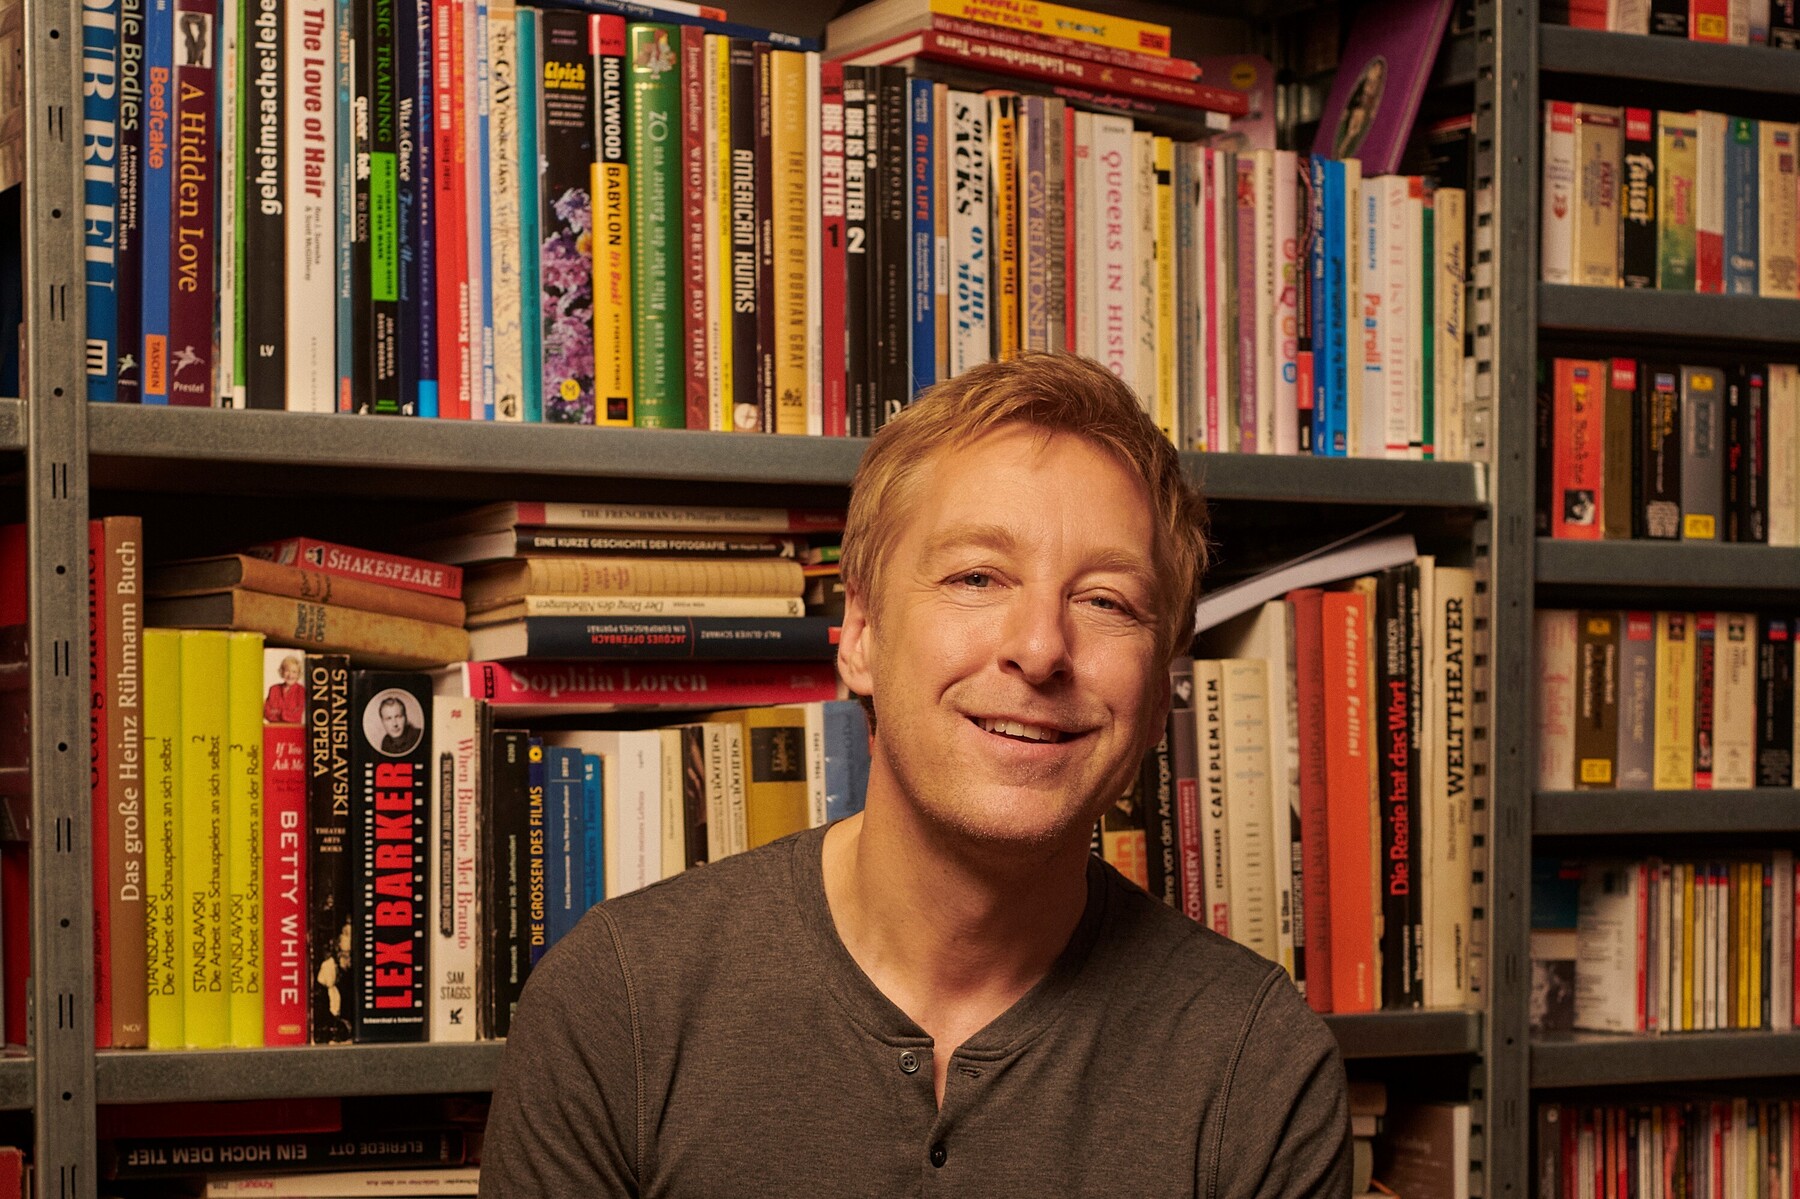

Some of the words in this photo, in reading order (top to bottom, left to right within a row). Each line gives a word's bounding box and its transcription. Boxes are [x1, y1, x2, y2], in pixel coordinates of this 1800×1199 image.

[121, 0, 142, 35] ale
[304, 9, 325, 51] The
[936, 35, 971, 57] Tiere
[971, 44, 987, 57] der
[121, 43, 143, 130] Bodies
[180, 81, 204, 102] A
[304, 58, 325, 112] Love
[149, 66, 169, 169] Beefcake
[255, 0, 283, 215] geheimsache:lebe
[354, 97, 369, 140] queer
[603, 57, 622, 160] HOLLYWOOD
[822, 104, 844, 132] BIG
[845, 108, 866, 137] BIG
[304, 119, 325, 141] of
[822, 134, 843, 154] IS
[845, 139, 866, 157] IS
[915, 134, 928, 156] fit
[179, 112, 206, 217] Hidden
[304, 147, 326, 199] Hair
[357, 152, 371, 181] folk
[690, 146, 702, 200] WHO'S
[915, 157, 928, 182] for
[954, 104, 973, 216] SACKS
[972, 119, 984, 205] OLIVER
[357, 193, 368, 210] the
[607, 166, 623, 246] BABYLON
[735, 149, 754, 245] AMERICAN
[822, 155, 844, 218] BETTER
[845, 159, 867, 222] BETTER
[915, 185, 929, 221] LIFE
[1029, 170, 1045, 217] GAY
[1100, 151, 1123, 252] QUEERS
[357, 213, 369, 243] book
[691, 205, 702, 217] A
[691, 222, 704, 283] PRETTY
[827, 223, 839, 249] 1
[846, 226, 866, 254] 2
[178, 228, 204, 292] Love
[609, 251, 621, 269] It's
[1108, 263, 1123, 292] IN
[609, 270, 622, 306] Back!
[735, 252, 755, 314] HUNKS
[457, 281, 470, 343] Kreutzer
[692, 289, 704, 321] BOY
[693, 327, 705, 378] THEN?
[1108, 304, 1124, 375] HISTO
[1364, 294, 1382, 372] Paaroll!
[151, 341, 160, 388] TASCHEN
[459, 347, 471, 401] Dietmar
[173, 382, 204, 393] Prestel
[533, 537, 556, 548] EINE
[557, 537, 589, 549] KURZE
[590, 538, 648, 550] GESCHICHTE
[648, 540, 669, 551] DER
[669, 540, 728, 551] FOTOGRAFIE
[115, 541, 136, 596] Buch
[327, 549, 444, 588] SHAKESPEARE
[115, 603, 138, 708] Rühmann
[591, 633, 646, 643] OFFENBACH
[647, 634, 687, 644] JACQUES
[1345, 605, 1358, 689] Federico
[312, 667, 330, 701] ON
[510, 666, 620, 698] Sophia
[621, 666, 709, 692] Loren
[1206, 679, 1219, 722] PLEM
[1446, 597, 1465, 798] WELTTHEATER
[1388, 680, 1407, 731] Wort
[192, 734, 205, 744] 2
[312, 708, 330, 777] OPERA
[331, 669, 350, 817] STANISLAVSKI
[1347, 695, 1361, 758] Fellini
[117, 715, 138, 781] Heinz
[160, 737, 172, 773] selbst
[208, 735, 221, 771] selbst
[230, 743, 243, 753] 3
[246, 744, 258, 775] Rolle
[457, 738, 474, 784] When
[1208, 727, 1221, 771] PLEM
[1389, 733, 1407, 764] das
[160, 775, 173, 799] sich
[208, 773, 221, 797] sich
[246, 778, 258, 800] der
[1206, 776, 1223, 820] CAFÉ
[1389, 764, 1408, 801] hat
[118, 787, 141, 854] große
[161, 801, 173, 818] an
[209, 799, 221, 816] an
[246, 801, 258, 818] an
[457, 787, 474, 853] Blanche
[529, 785, 543, 827] FILMS
[375, 762, 413, 927] BARKER
[414, 762, 424, 939] BIOGRAPHIE
[530, 828, 544, 855] DES
[1389, 804, 1409, 860] Regie
[161, 820, 177, 901] Schauspielers
[208, 818, 224, 899] Schauspielers
[245, 819, 261, 901] Schauspielers
[279, 810, 298, 901] BETTY
[457, 856, 474, 887] Met
[507, 834, 517, 884] Jahrhundert
[120, 858, 140, 902] Das
[508, 884, 517, 897] 20.
[530, 859, 545, 921] GROSSEN
[1186, 849, 1201, 921] CONNERY
[1390, 861, 1409, 896] Die
[161, 903, 174, 926] des
[209, 901, 221, 924] des
[246, 902, 259, 926] des
[458, 892, 474, 950] Brando
[508, 897, 518, 908] im
[193, 891, 205, 993] STANISLAWSKI
[231, 893, 243, 994] STANISLAWSKI
[508, 909, 518, 939] Theater
[531, 923, 545, 945] DIE
[147, 894, 159, 997] STANISLAWSKI
[161, 929, 175, 969] Arbeit
[209, 927, 222, 967] Arbeit
[246, 929, 259, 968] Arbeit
[279, 913, 299, 1006] WHITE
[508, 946, 518, 984] Brauneck
[162, 971, 175, 996] Die
[210, 970, 222, 993] Die
[247, 971, 259, 995] Die
[375, 939, 413, 1010] LEX
[440, 987, 472, 999] STAGGS
[447, 973, 464, 985] SAM
[128, 1148, 167, 1166] TIEF
[172, 1147, 214, 1164] DEM
[220, 1146, 272, 1162] HOCH
[277, 1143, 308, 1161] EIN
[328, 1142, 356, 1156] OTT
[360, 1140, 424, 1155] ELFRIEDE
